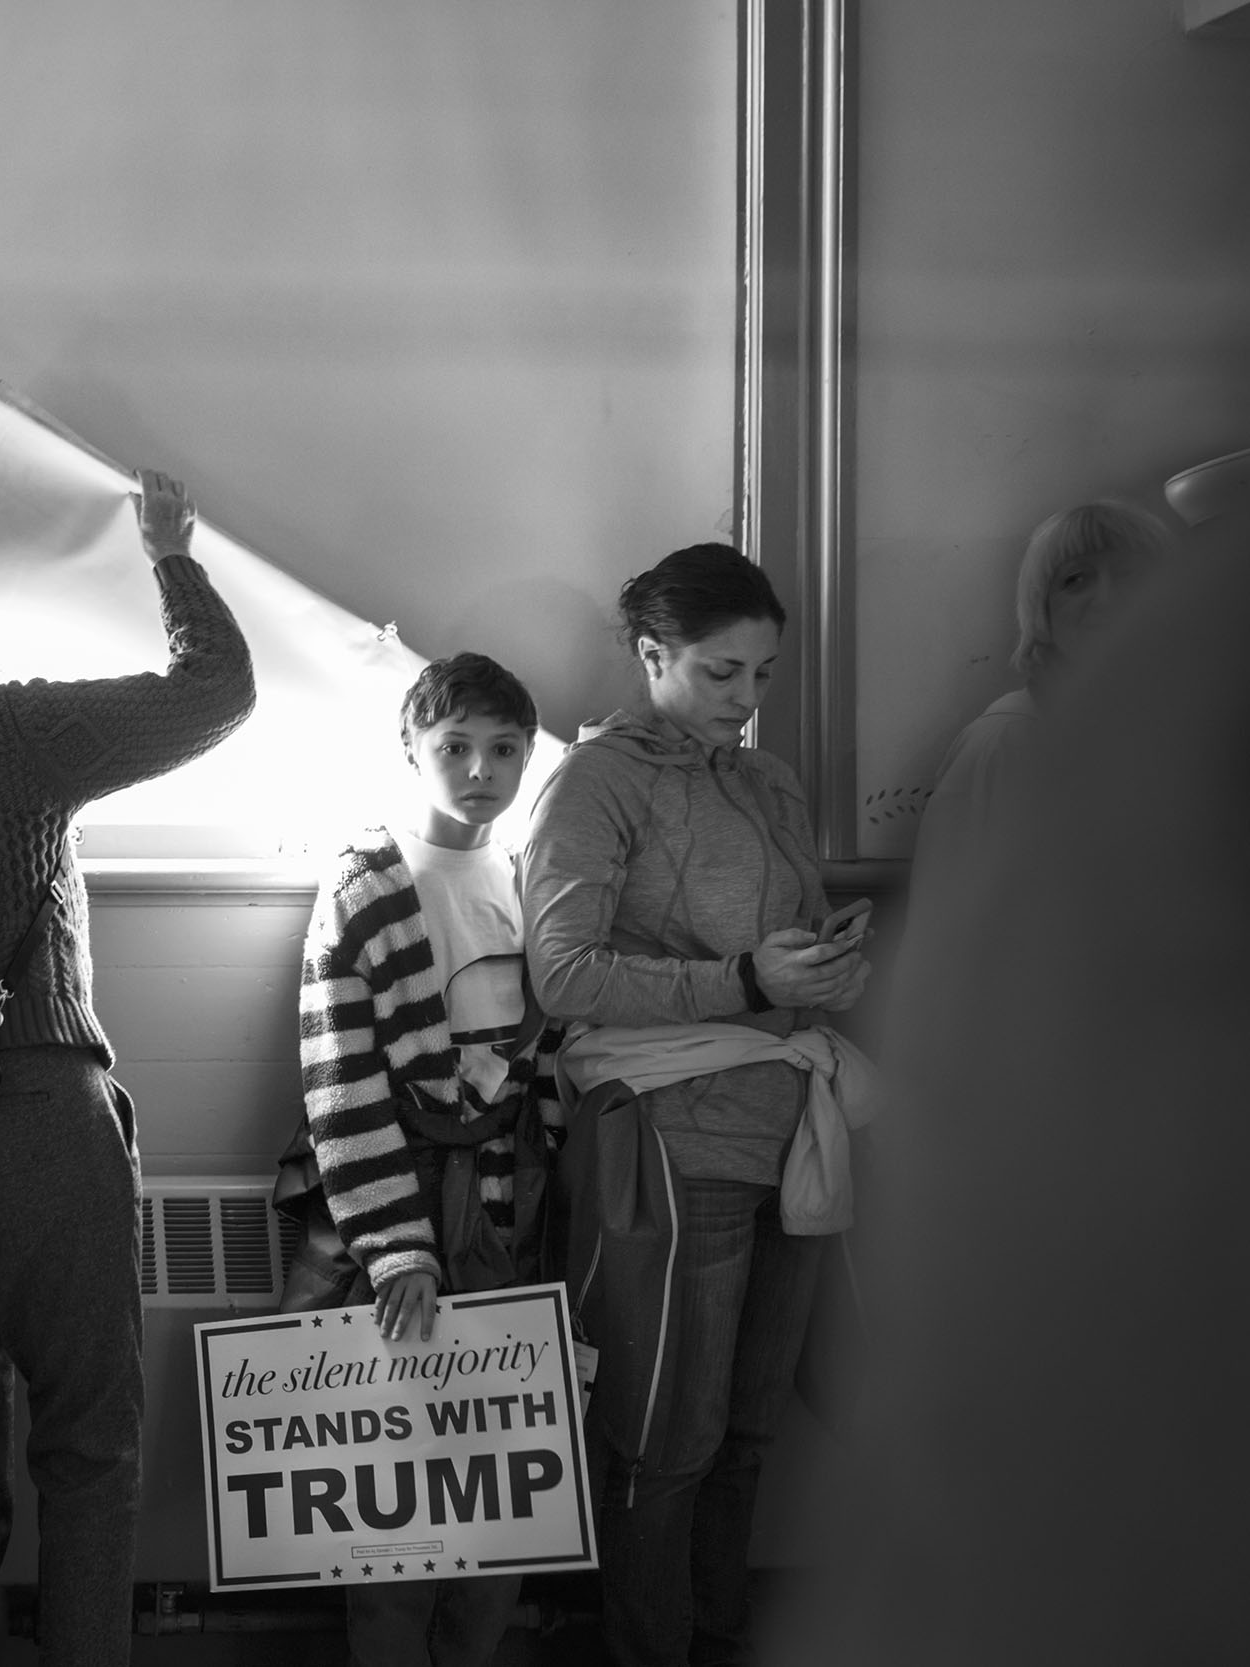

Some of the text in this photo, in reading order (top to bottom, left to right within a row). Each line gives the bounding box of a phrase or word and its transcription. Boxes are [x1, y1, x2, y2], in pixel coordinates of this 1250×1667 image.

[221, 1333, 549, 1399] the silent majority
[225, 1391, 557, 1455] STANDS WITH
[227, 1449, 564, 1539] TRUMP
